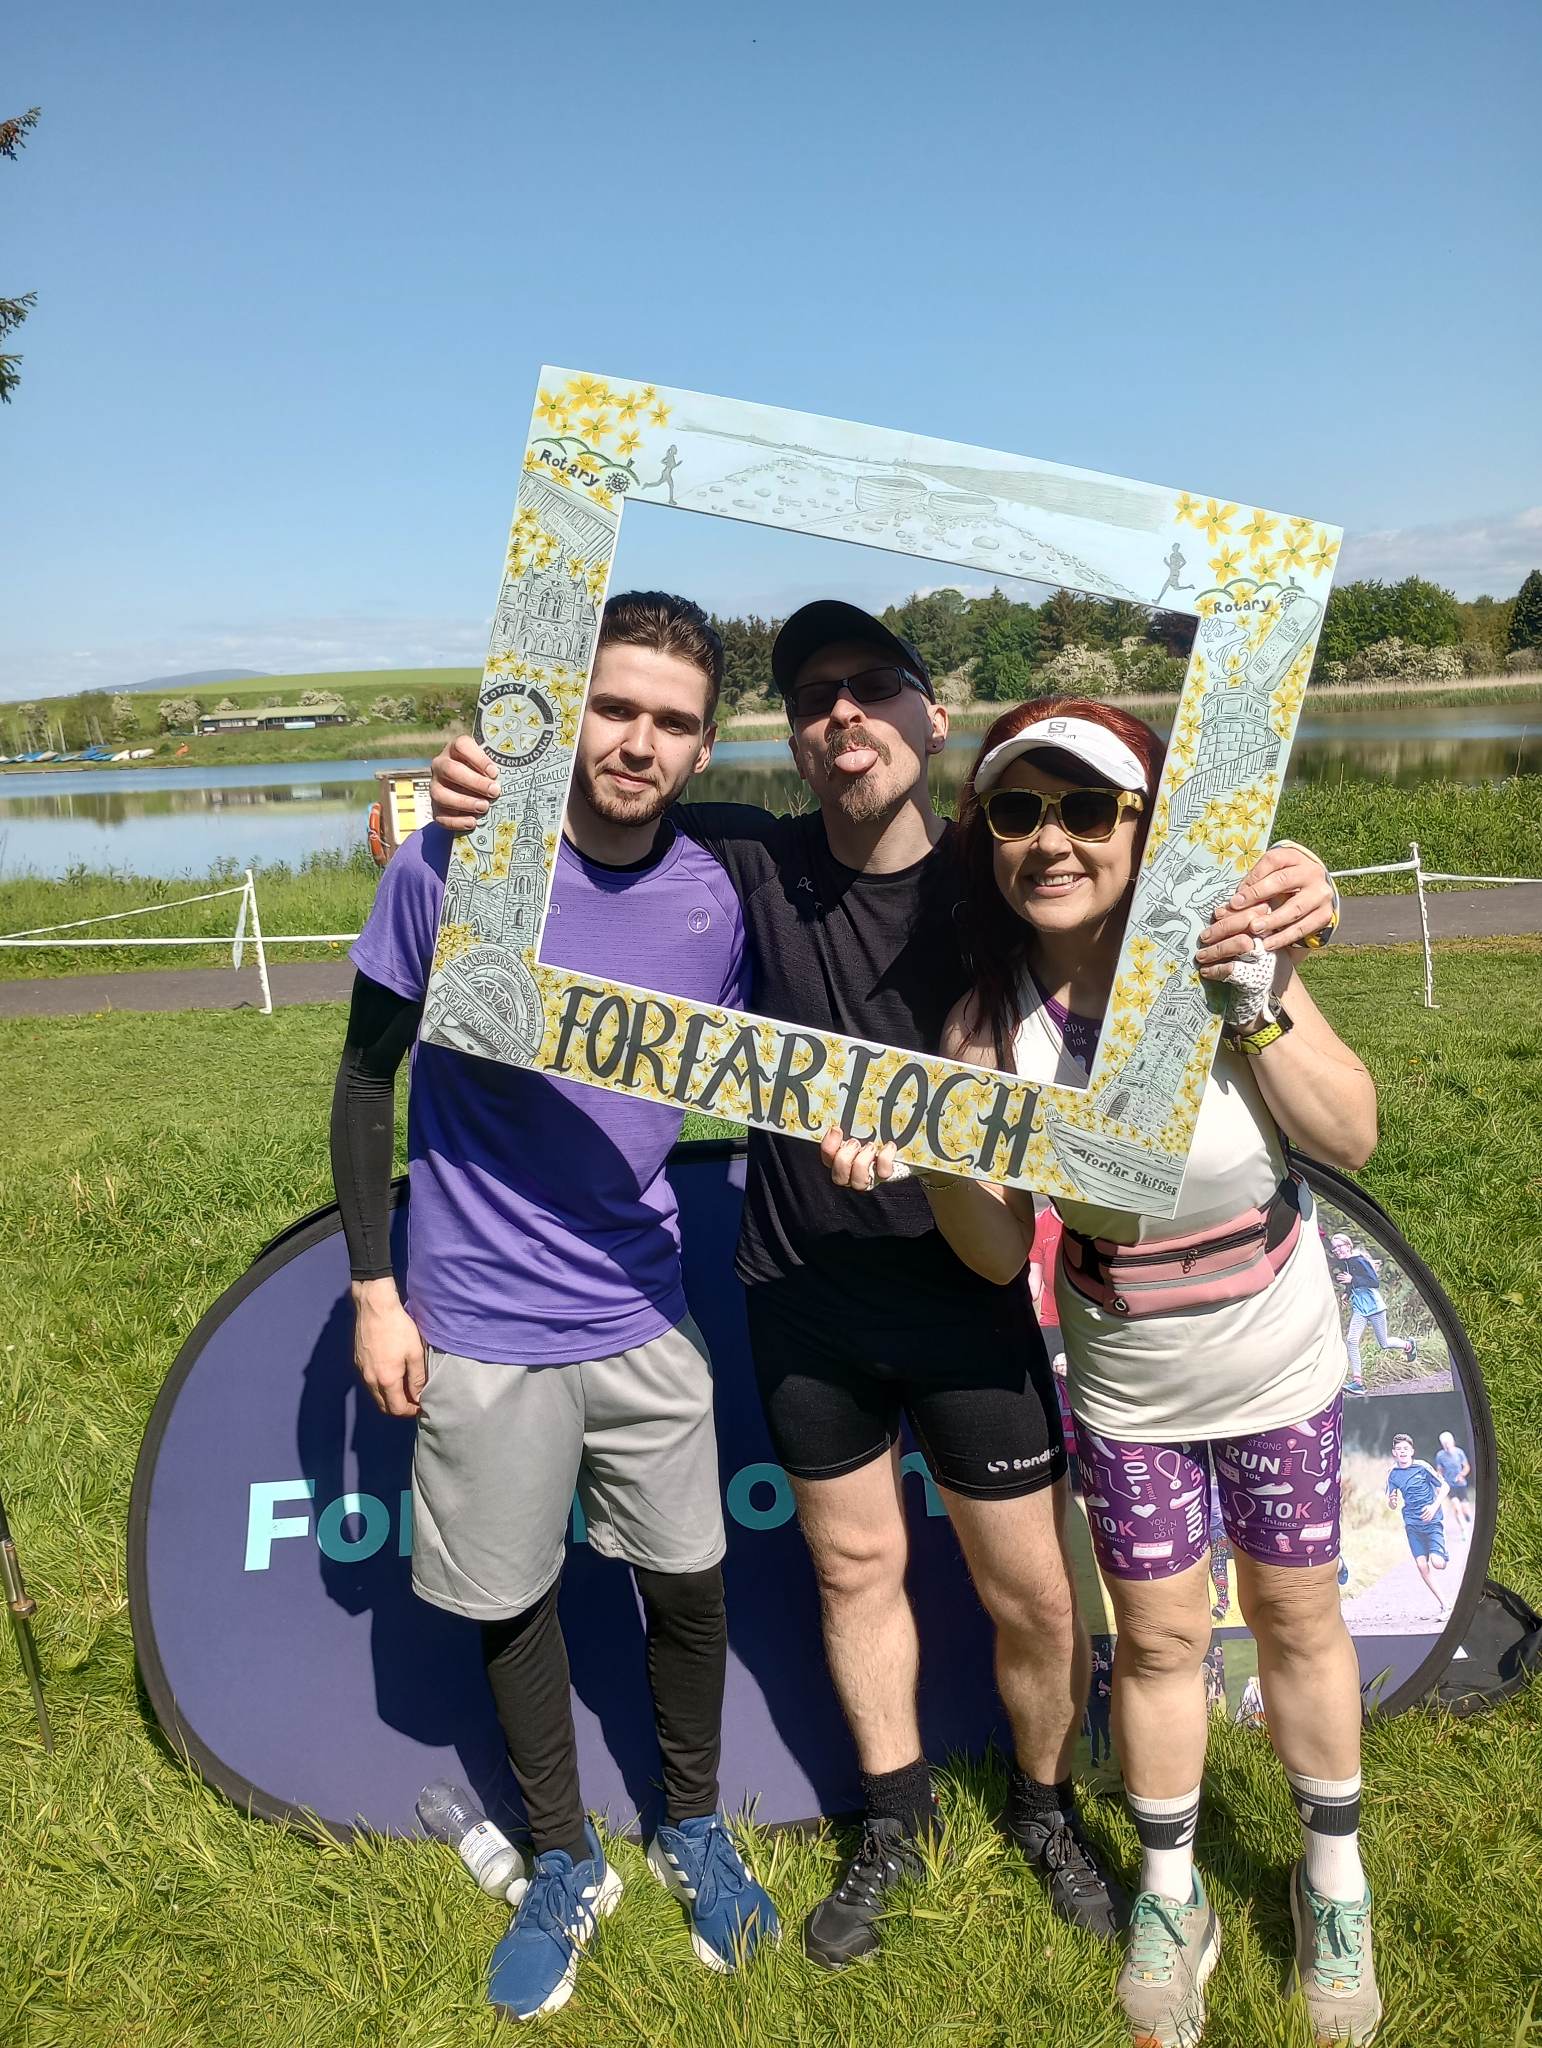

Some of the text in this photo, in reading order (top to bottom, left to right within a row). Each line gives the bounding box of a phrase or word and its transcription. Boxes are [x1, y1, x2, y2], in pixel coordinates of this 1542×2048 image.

[540, 449, 601, 487] Rotary
[1214, 599, 1271, 614] Rotary
[482, 684, 524, 704] ROTARY
[485, 731, 552, 767] INTERNATIONAL
[543, 985, 1044, 1178] FORFAR LOCH
[1086, 1153, 1178, 1196] Forfar Skiffies
[1247, 1439, 1282, 1452] STRONG
[1320, 1414, 1334, 1459] 10K
[1013, 1445, 1060, 1470] Sondico
[1120, 1447, 1151, 1485] 10K
[1225, 1444, 1281, 1475] RUN
[1244, 1471, 1262, 1481] 10k
[1149, 1517, 1167, 1527] YOU
[1184, 1497, 1204, 1544] RUN
[1261, 1500, 1313, 1519] 10K
[1261, 1516, 1298, 1528] distance
[1092, 1511, 1137, 1538] 10K
